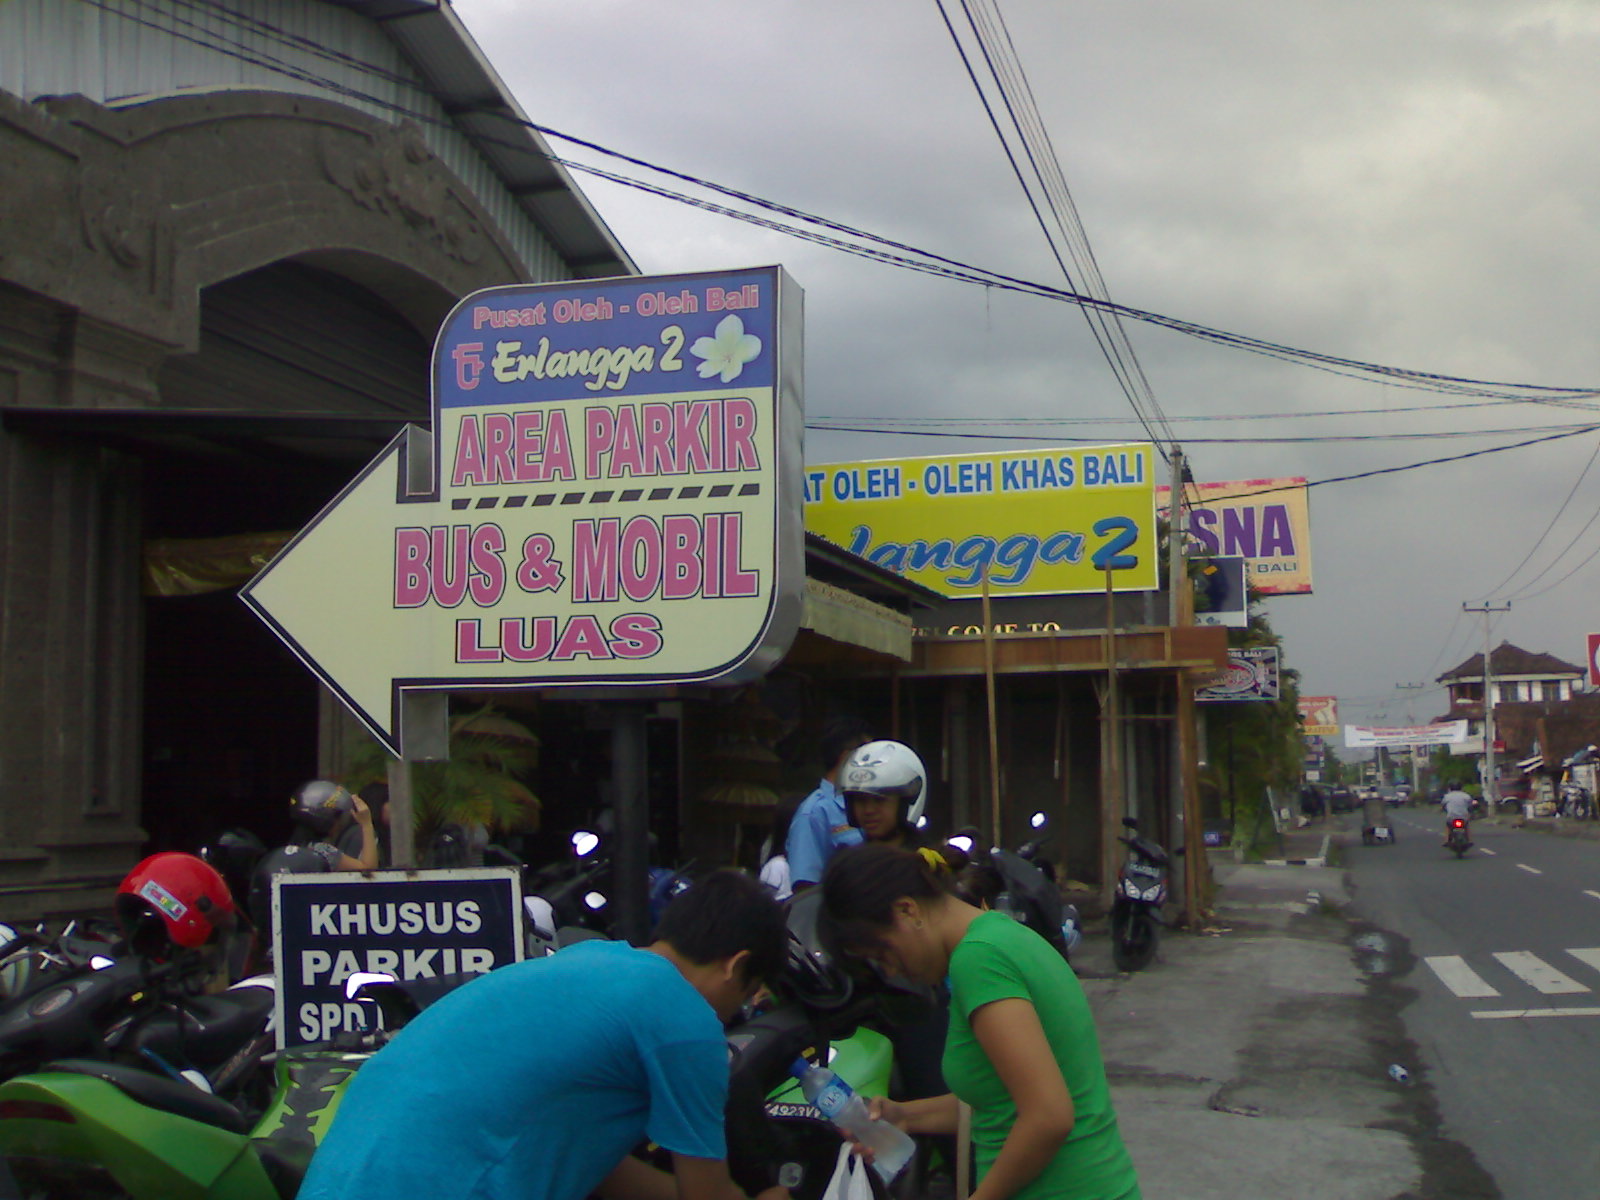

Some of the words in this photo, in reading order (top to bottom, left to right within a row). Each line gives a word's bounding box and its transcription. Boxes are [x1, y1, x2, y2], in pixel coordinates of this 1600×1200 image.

[473, 302, 546, 330] Pusat
[553, 297, 613, 323] Oleh
[636, 290, 698, 317] Oleh
[706, 284, 759, 312] Bali
[491, 336, 655, 391] Erlangga
[659, 325, 685, 372] 2
[451, 409, 576, 486] AREA
[585, 397, 761, 479] PARKIR
[833, 467, 900, 500] OLEH
[924, 462, 992, 495] OLEH
[1002, 456, 1074, 491] KHAS
[1083, 453, 1143, 485] BALI
[393, 522, 507, 608] BUS
[516, 533, 566, 593] &
[571, 511, 760, 602] MOBIL
[1091, 515, 1139, 571] 2
[1257, 562, 1297, 573] BALI
[455, 612, 663, 663] LUAS
[310, 900, 482, 936] KHUSUS
[301, 948, 495, 986] PARKIR
